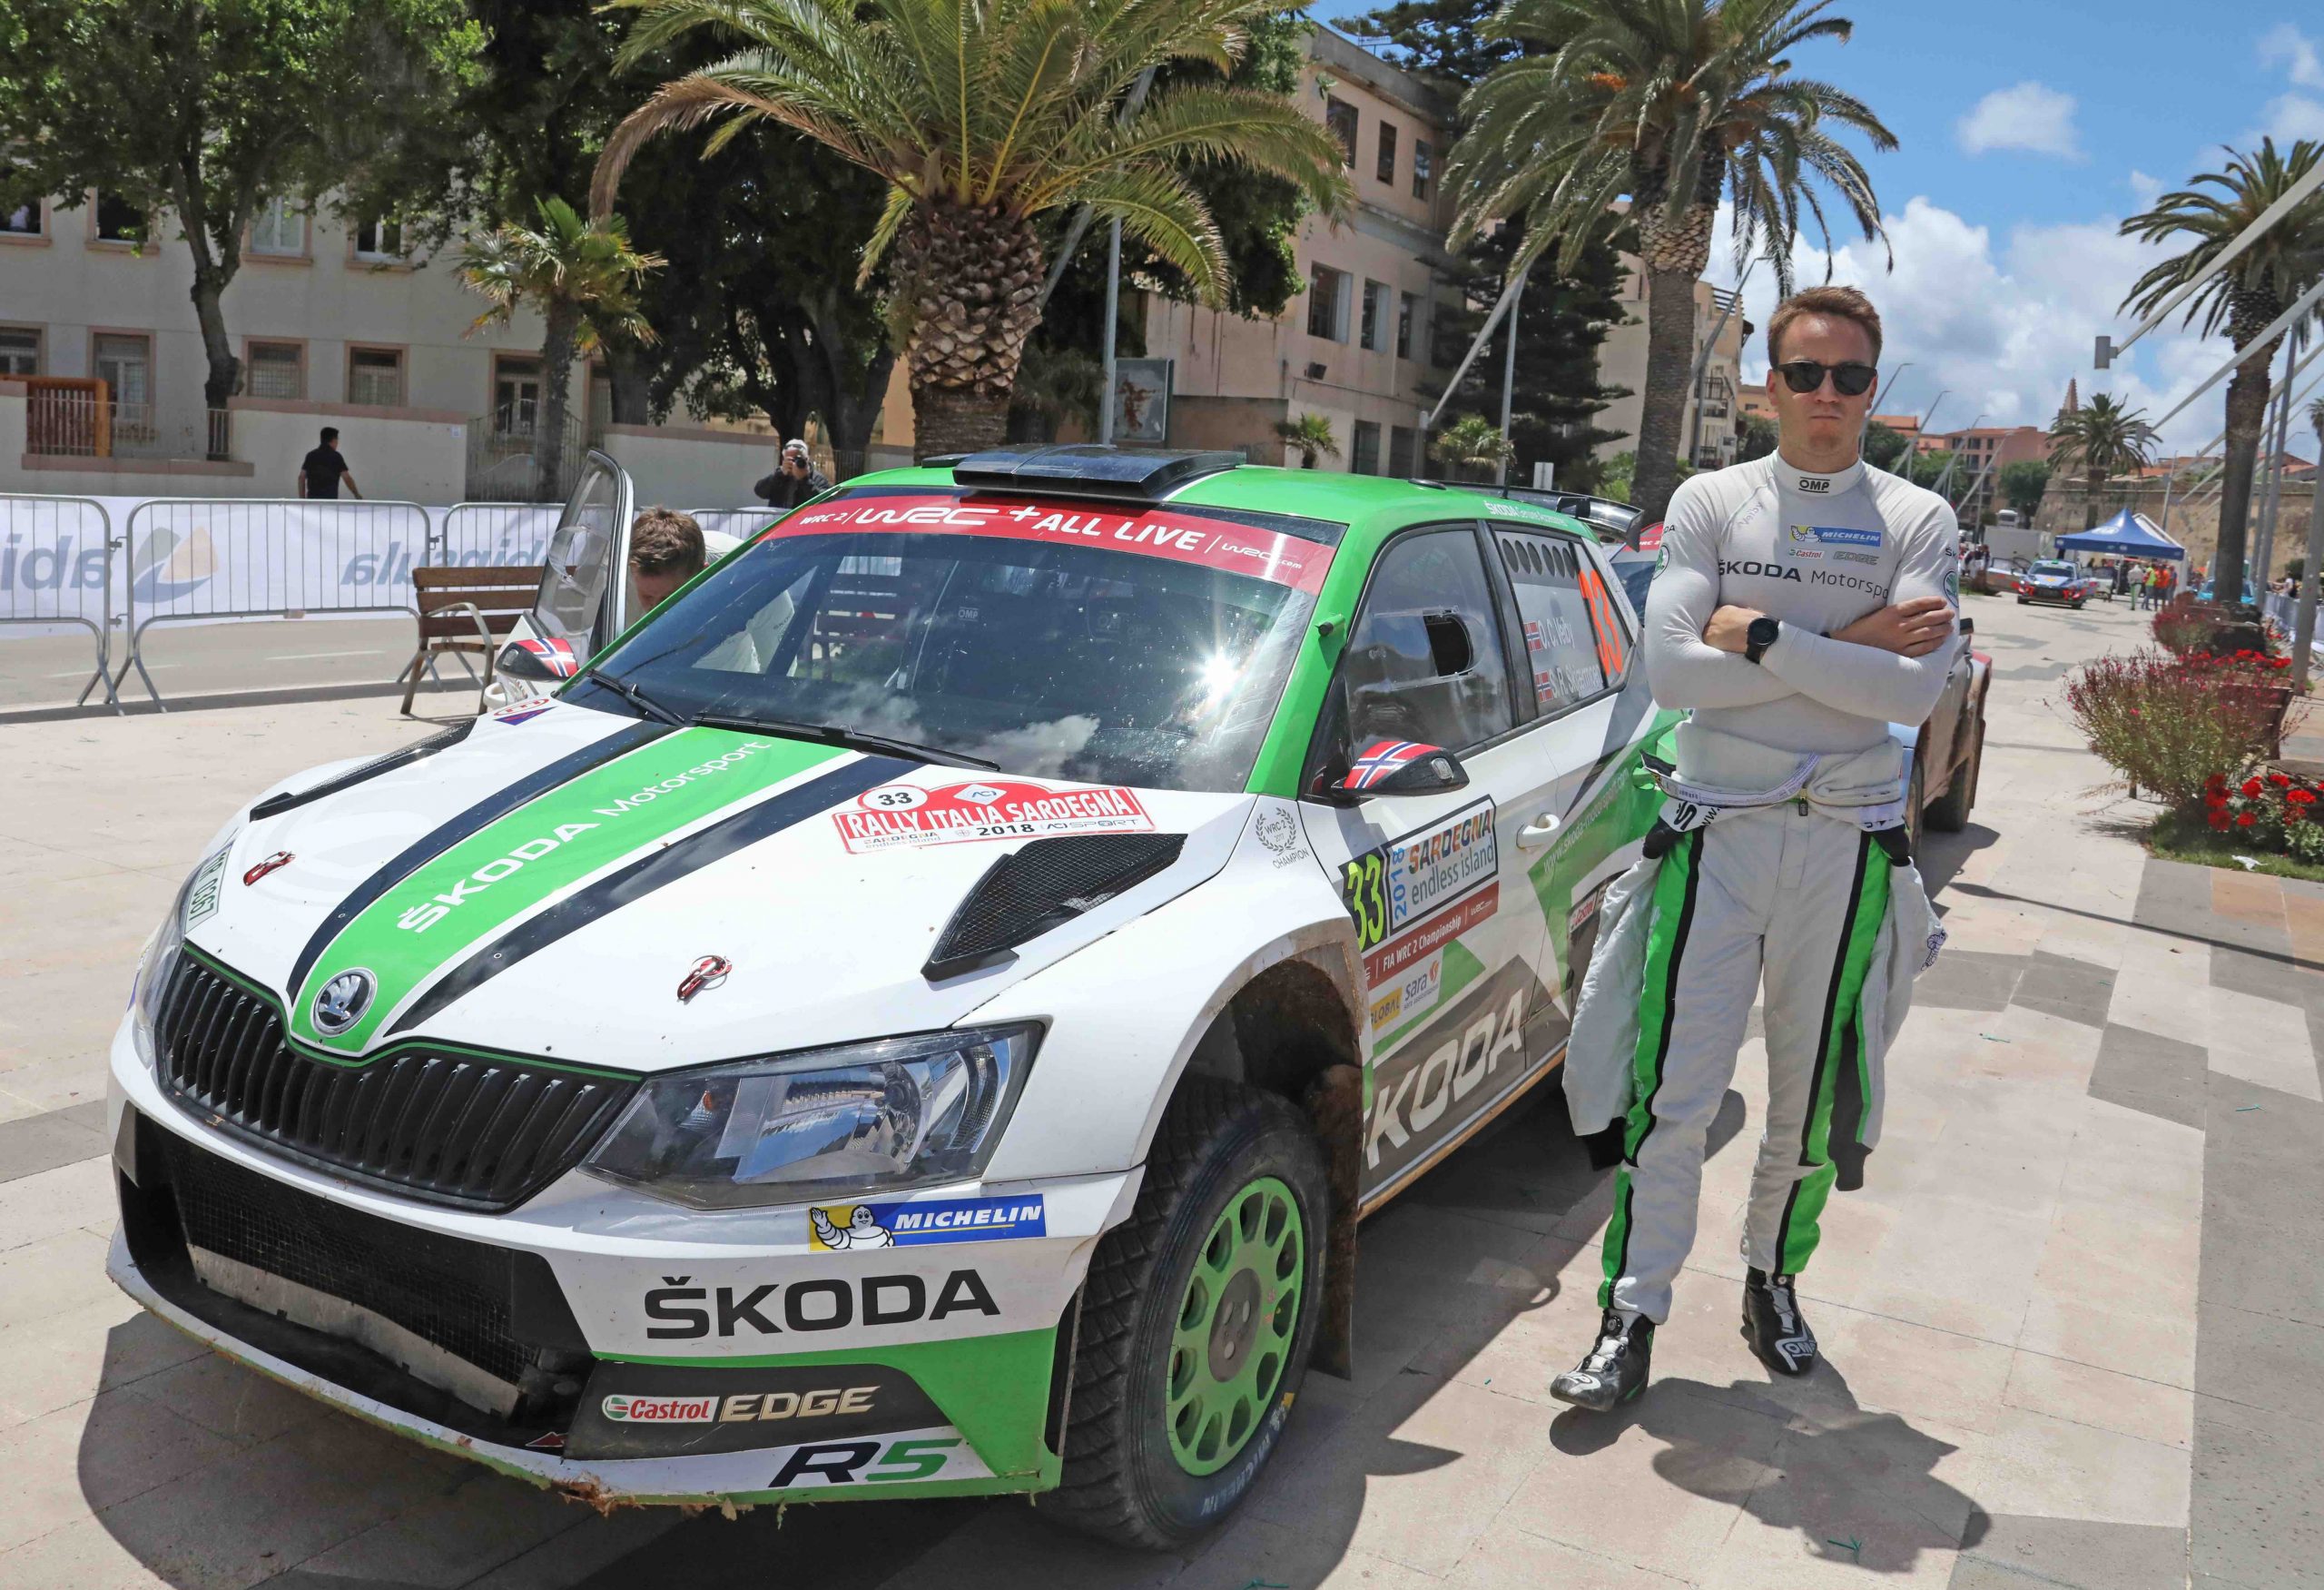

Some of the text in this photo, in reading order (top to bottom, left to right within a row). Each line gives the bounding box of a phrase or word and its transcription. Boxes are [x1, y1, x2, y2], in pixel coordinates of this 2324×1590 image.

[1798, 479, 1829, 490] OMP
[800, 512, 845, 525] WRC 2
[1114, 521, 1206, 550] LIVE
[1821, 531, 1880, 541] MICHELIN
[1796, 550, 1879, 565] Castrol EDGE
[958, 609, 979, 619] OMP
[592, 741, 771, 817] Motorsport
[847, 789, 1135, 838] RALLY ITALIA SARDEGNA
[878, 792, 913, 806] 33
[863, 832, 939, 844] SARDEGNA
[976, 824, 1035, 836] 2018
[1069, 819, 1138, 829] SPORT
[1265, 820, 1287, 835] WRC 2
[1408, 809, 1492, 874] SARDEGNA
[1273, 848, 1310, 869] CHAMPION
[1412, 837, 1494, 904] endless island
[397, 822, 601, 933] ŠKODA
[1392, 847, 1407, 921] 2018
[189, 878, 219, 922] 0367
[1347, 854, 1384, 952] 33
[1383, 914, 1462, 972] FIA WRC 2 Championship
[1405, 973, 1427, 1001] sara
[1364, 988, 1522, 1170] KODA
[895, 1206, 1041, 1230] MICHELIN
[644, 1269, 1001, 1339] ŠKODA
[630, 1385, 881, 1423] Castrol EDGE
[769, 1438, 963, 1488] R5
